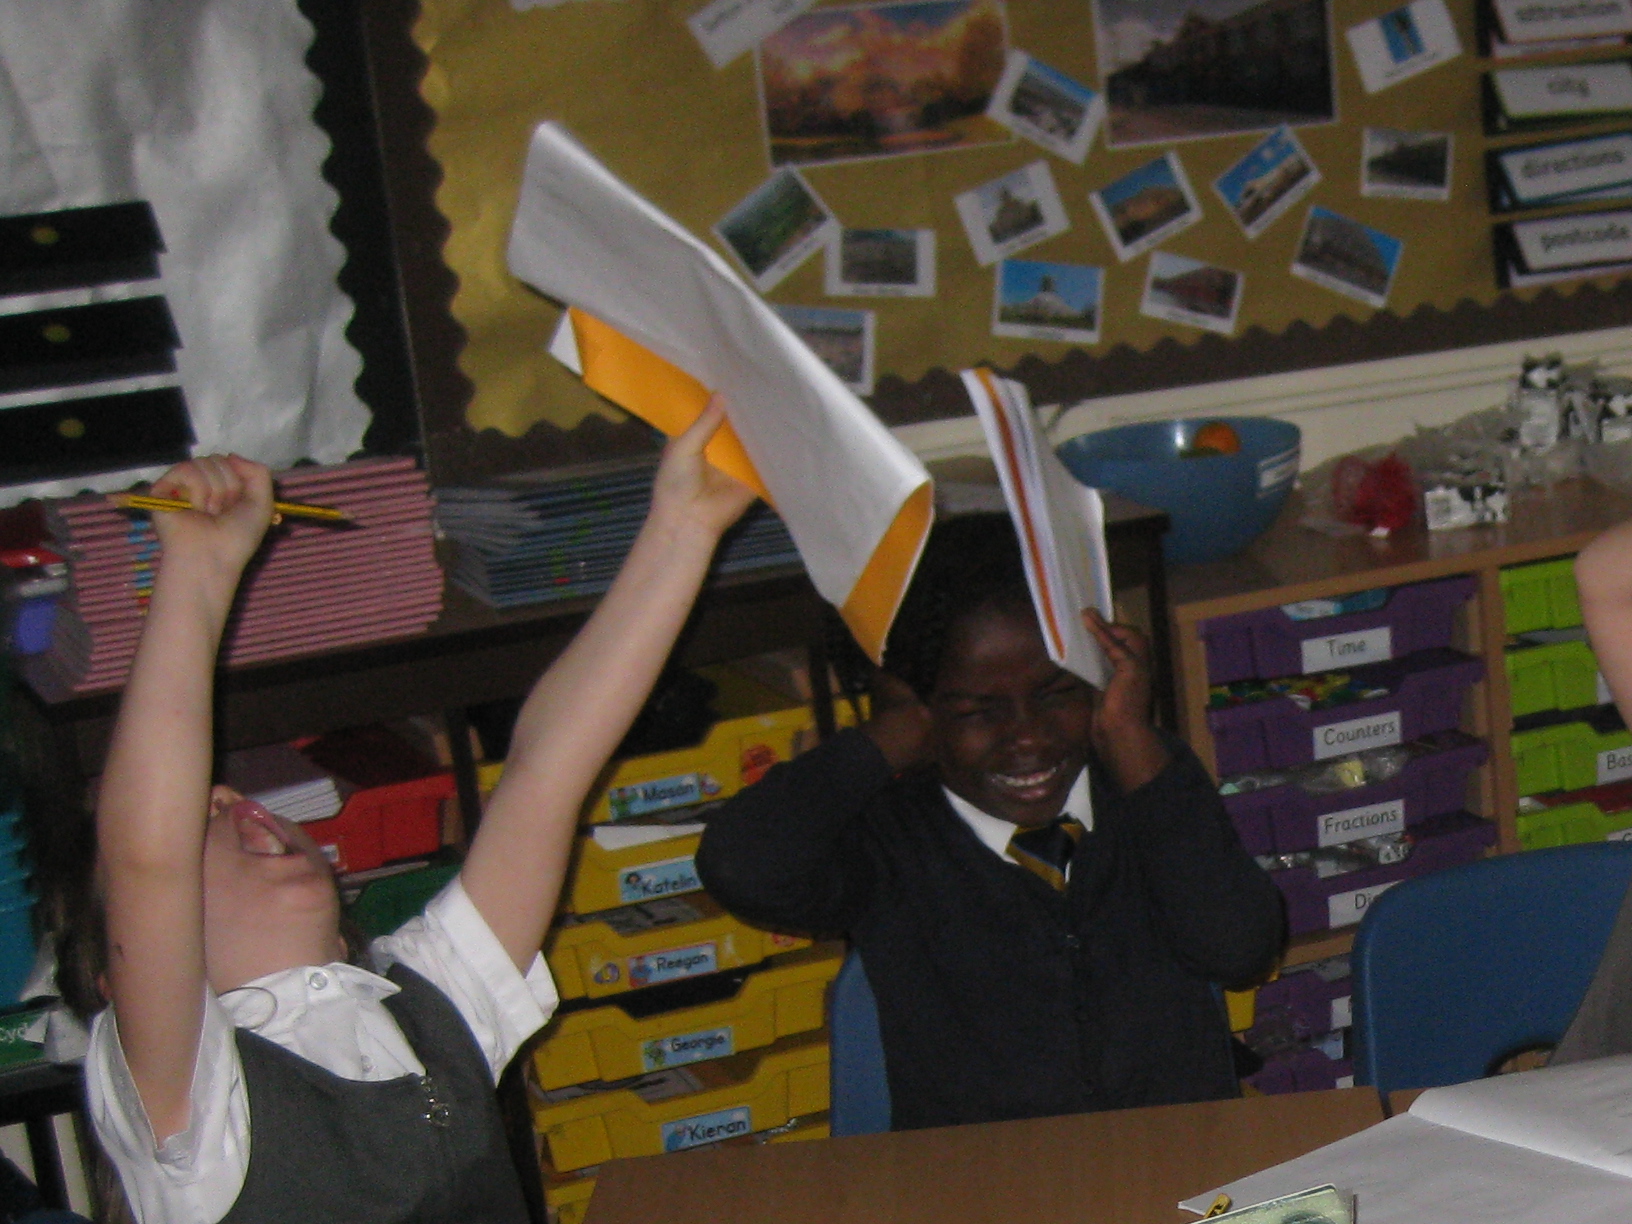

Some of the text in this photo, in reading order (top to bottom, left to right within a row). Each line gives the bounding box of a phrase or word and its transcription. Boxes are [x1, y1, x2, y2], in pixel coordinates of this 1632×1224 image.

[1326, 638, 1367, 658] Time
[1322, 718, 1396, 747] Counters
[1323, 808, 1398, 836] Fractions
[688, 1119, 747, 1141] Kieran
